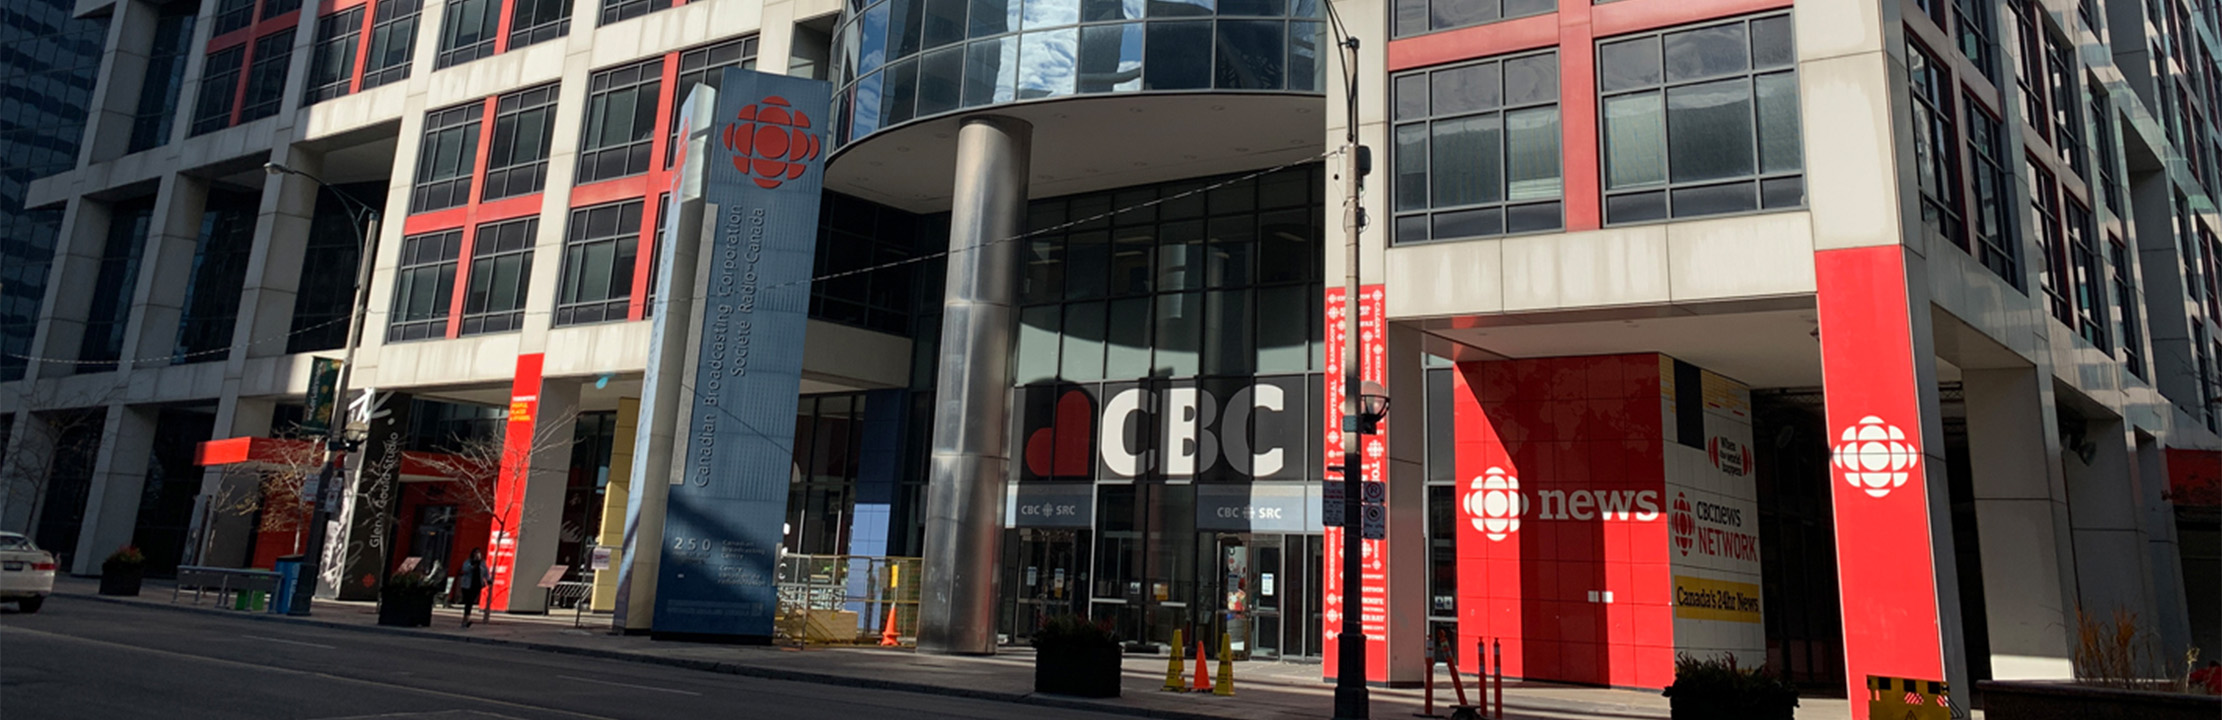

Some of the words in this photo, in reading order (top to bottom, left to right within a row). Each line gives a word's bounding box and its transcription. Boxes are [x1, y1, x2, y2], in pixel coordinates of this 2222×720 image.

[717, 204, 743, 298] Corporation
[738, 207, 765, 313] Radio-Canada
[704, 303, 734, 407] Broadcasting
[730, 320, 751, 377] Société
[1101, 383, 1284, 477] CBC
[383, 432, 398, 469] Studio
[694, 414, 717, 487] Canadian
[375, 473, 391, 509] Gould
[1537, 489, 1659, 521] news
[1021, 504, 1041, 516] CBC
[1055, 505, 1076, 516] SRC
[1216, 506, 1239, 518] CBC
[1258, 507, 1282, 519] SRC
[369, 512, 384, 548] Glenn
[674, 536, 712, 551] 250
[1698, 527, 1758, 563] NETWORK
[1677, 585, 1716, 609] Canada's
[1716, 590, 1736, 611] 24hr
[1736, 592, 1759, 612] News
